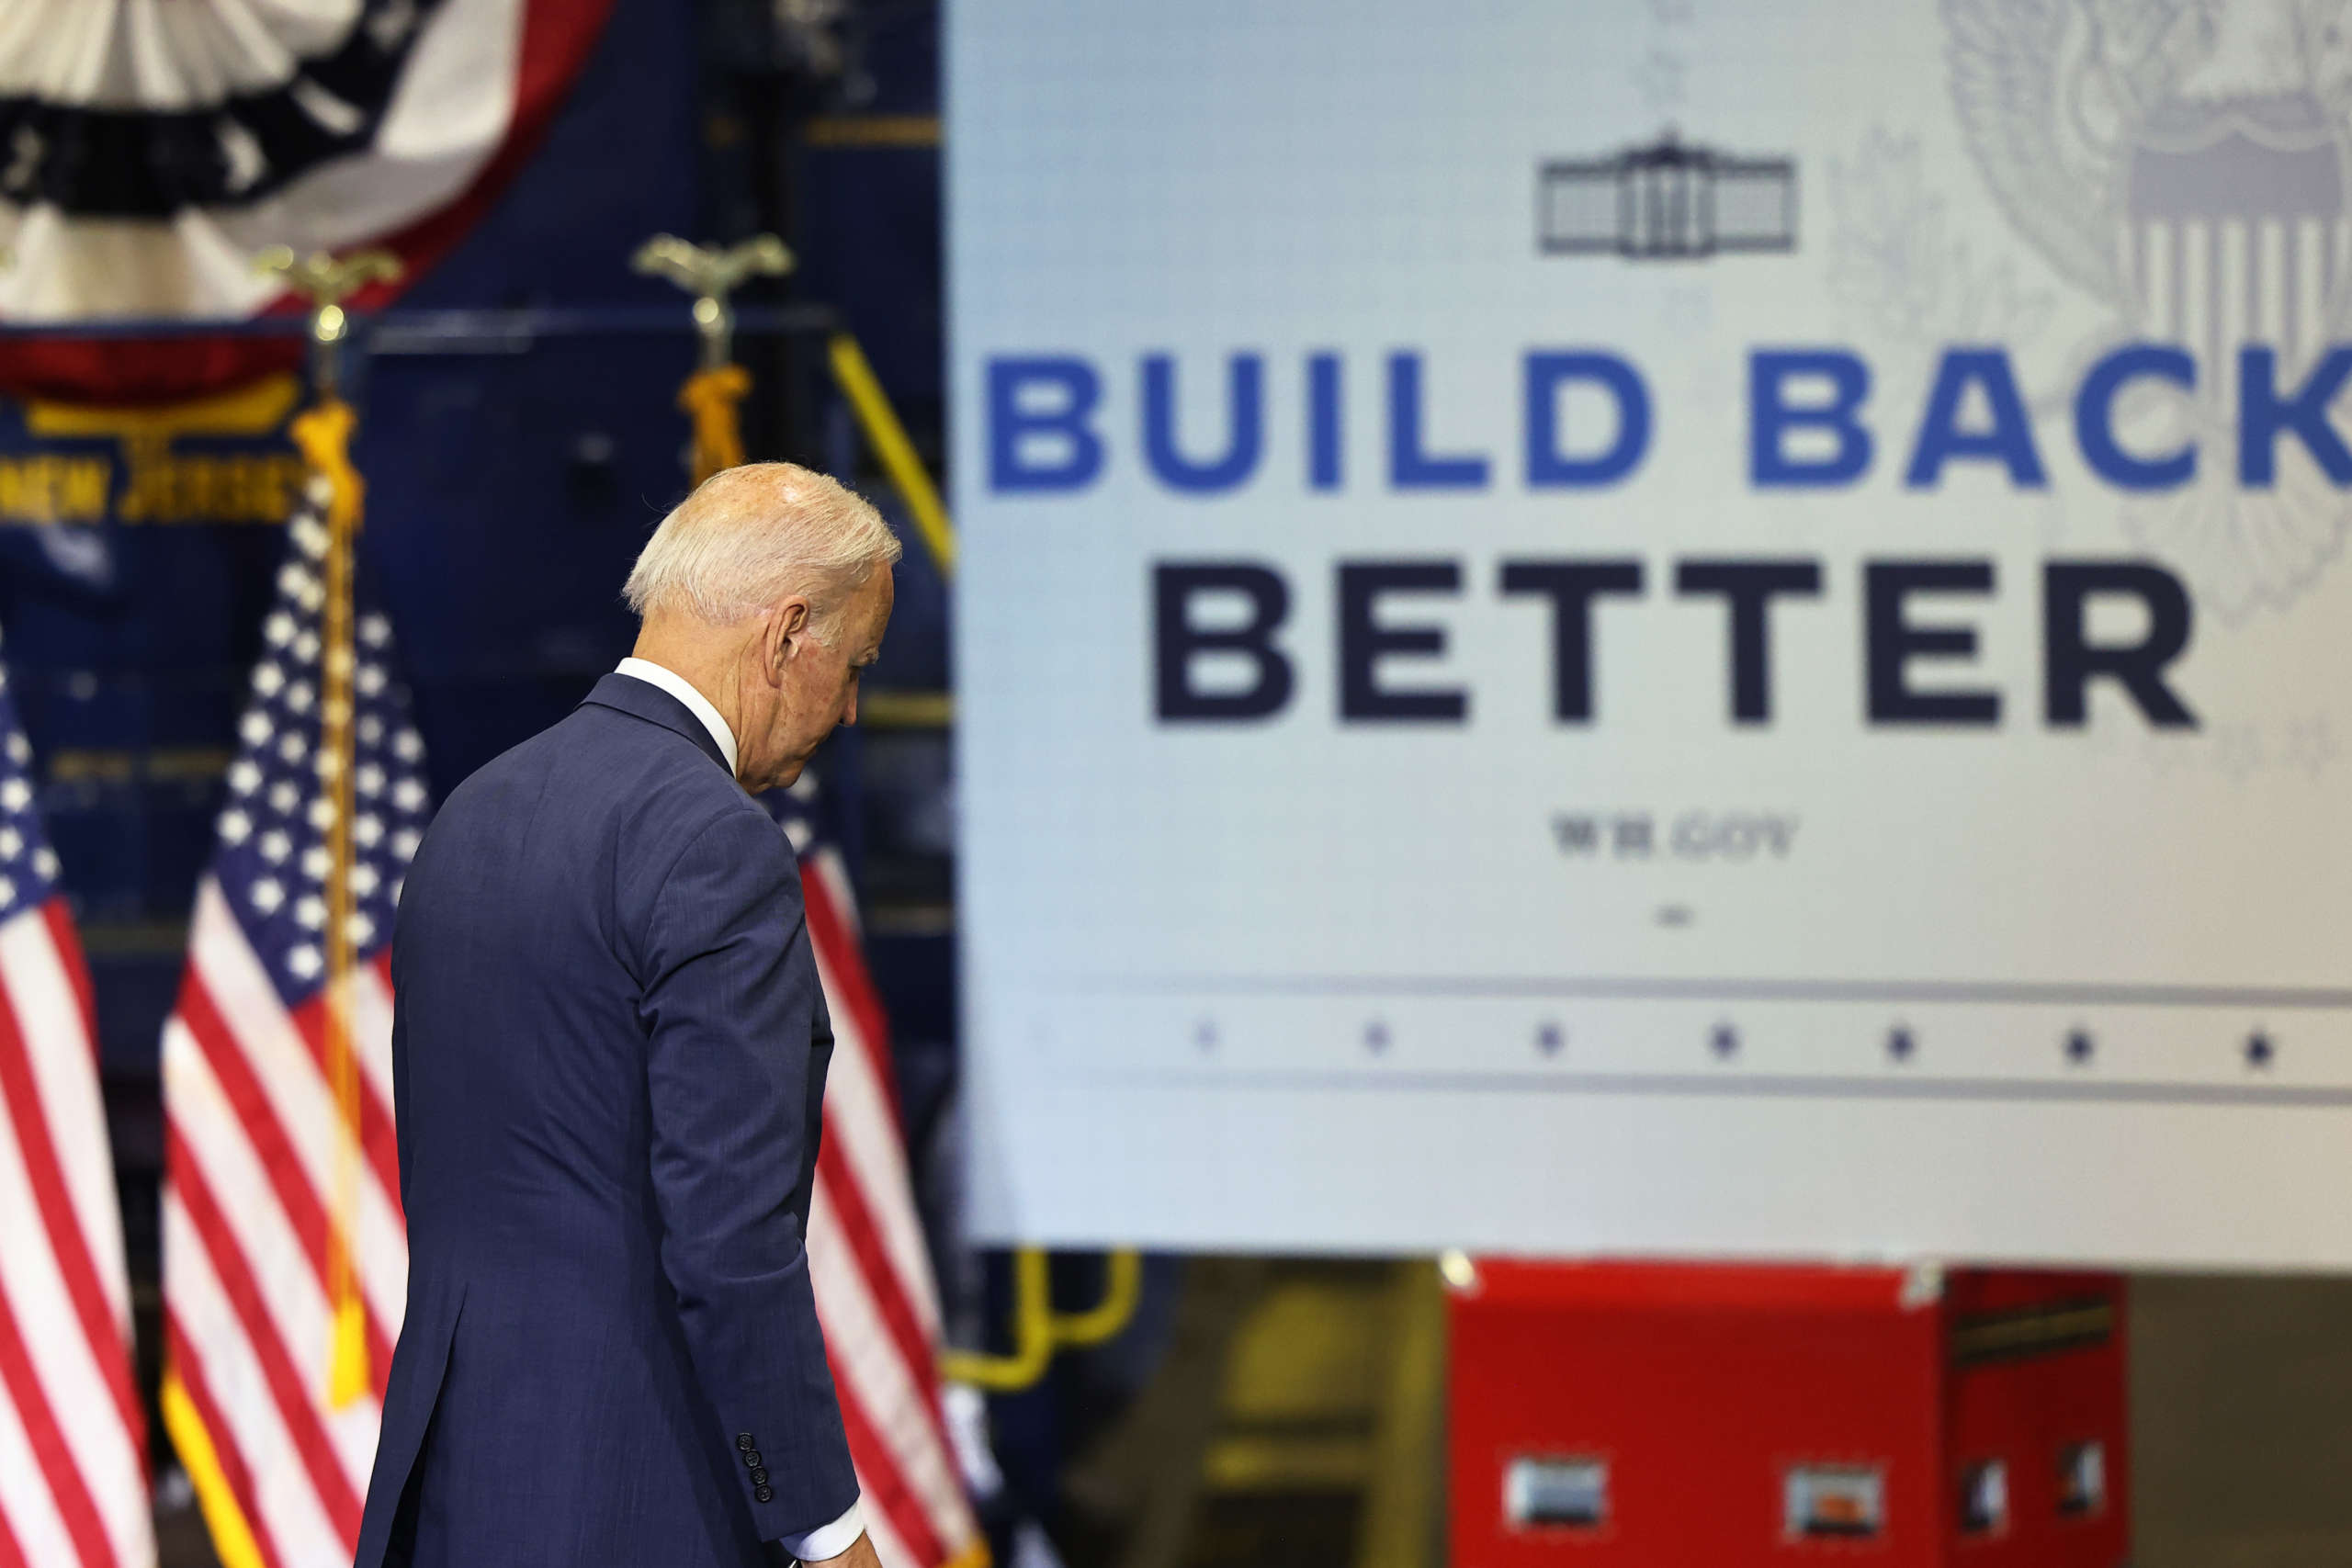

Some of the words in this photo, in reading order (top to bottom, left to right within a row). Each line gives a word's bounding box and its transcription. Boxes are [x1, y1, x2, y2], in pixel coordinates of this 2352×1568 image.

[981, 349, 1657, 497] BUILD
[1747, 342, 2352, 496] BACK
[1147, 555, 2204, 736] BETTER
